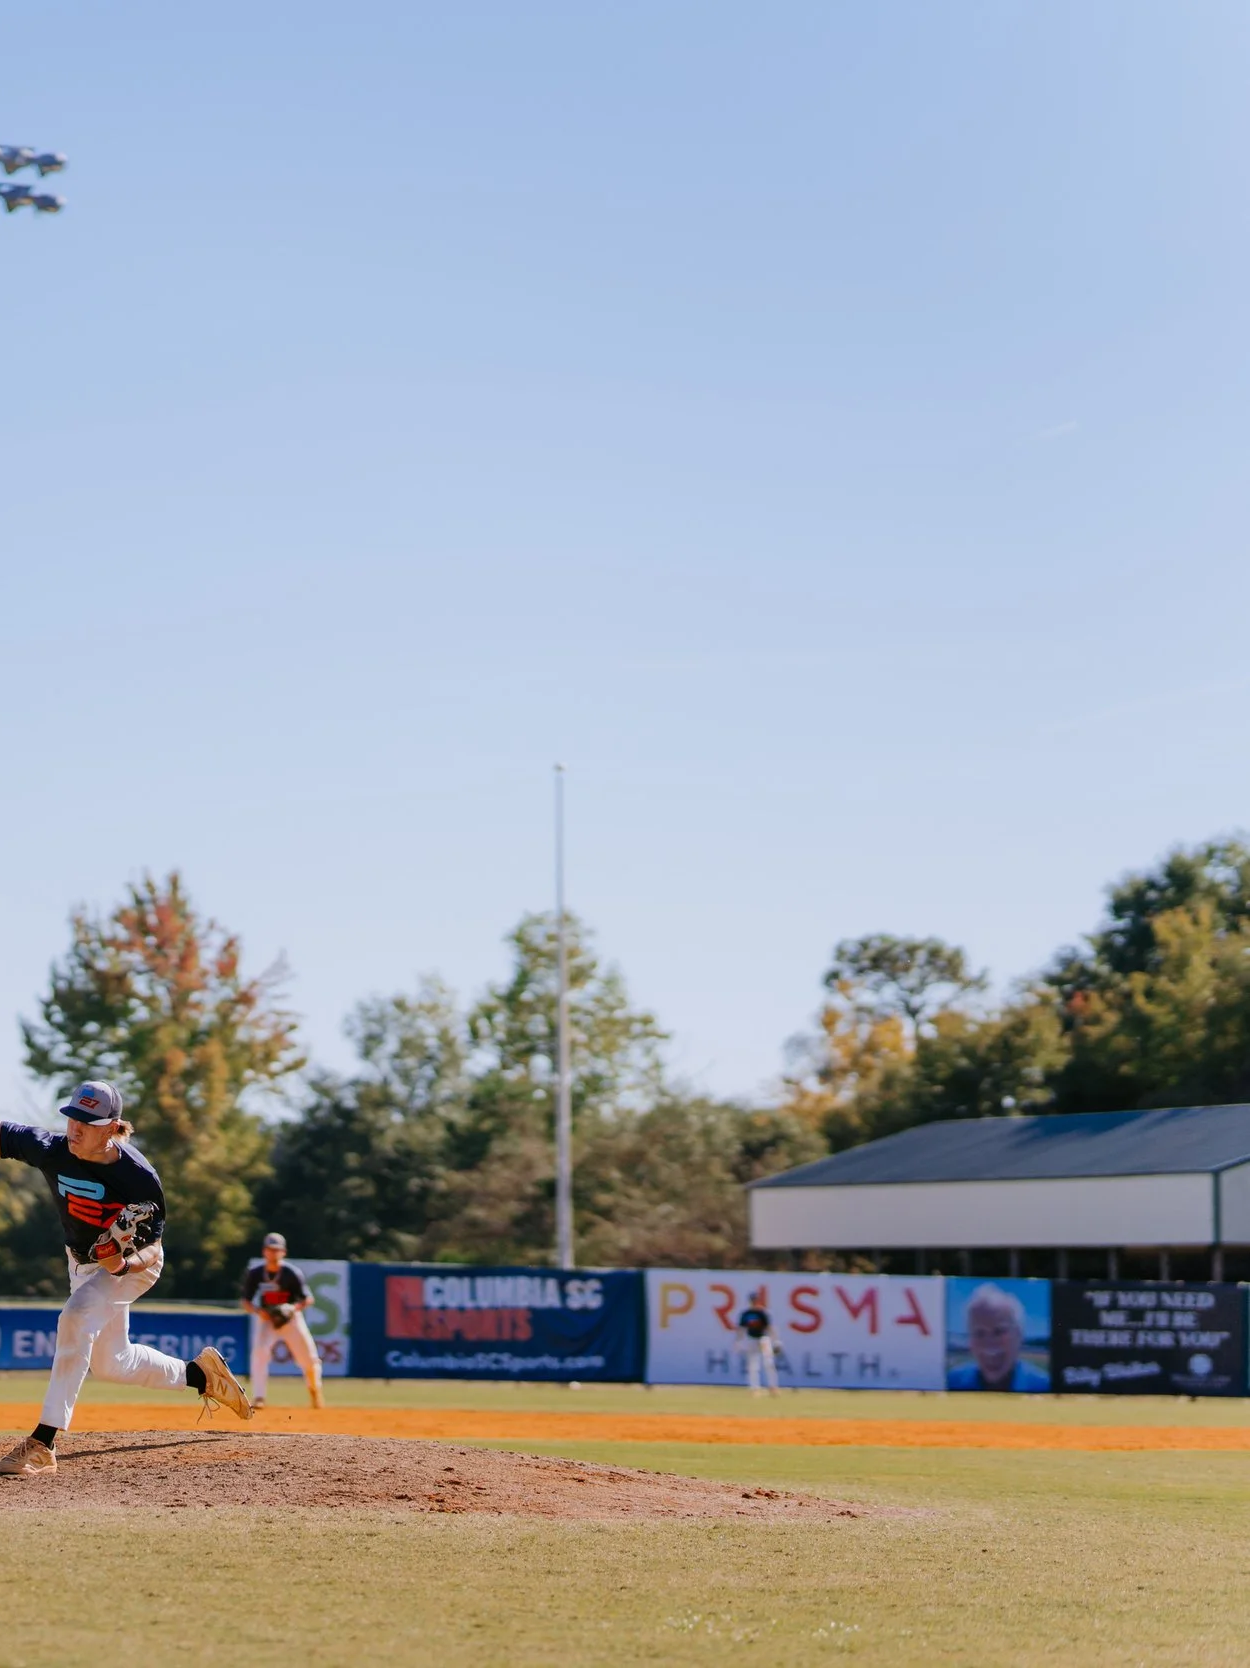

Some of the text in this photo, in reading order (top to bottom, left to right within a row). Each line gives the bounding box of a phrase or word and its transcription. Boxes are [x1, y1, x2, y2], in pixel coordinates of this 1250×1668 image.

[424, 1276, 603, 1310] COLUMBIA SC
[12, 1330, 236, 1361] ENERING
